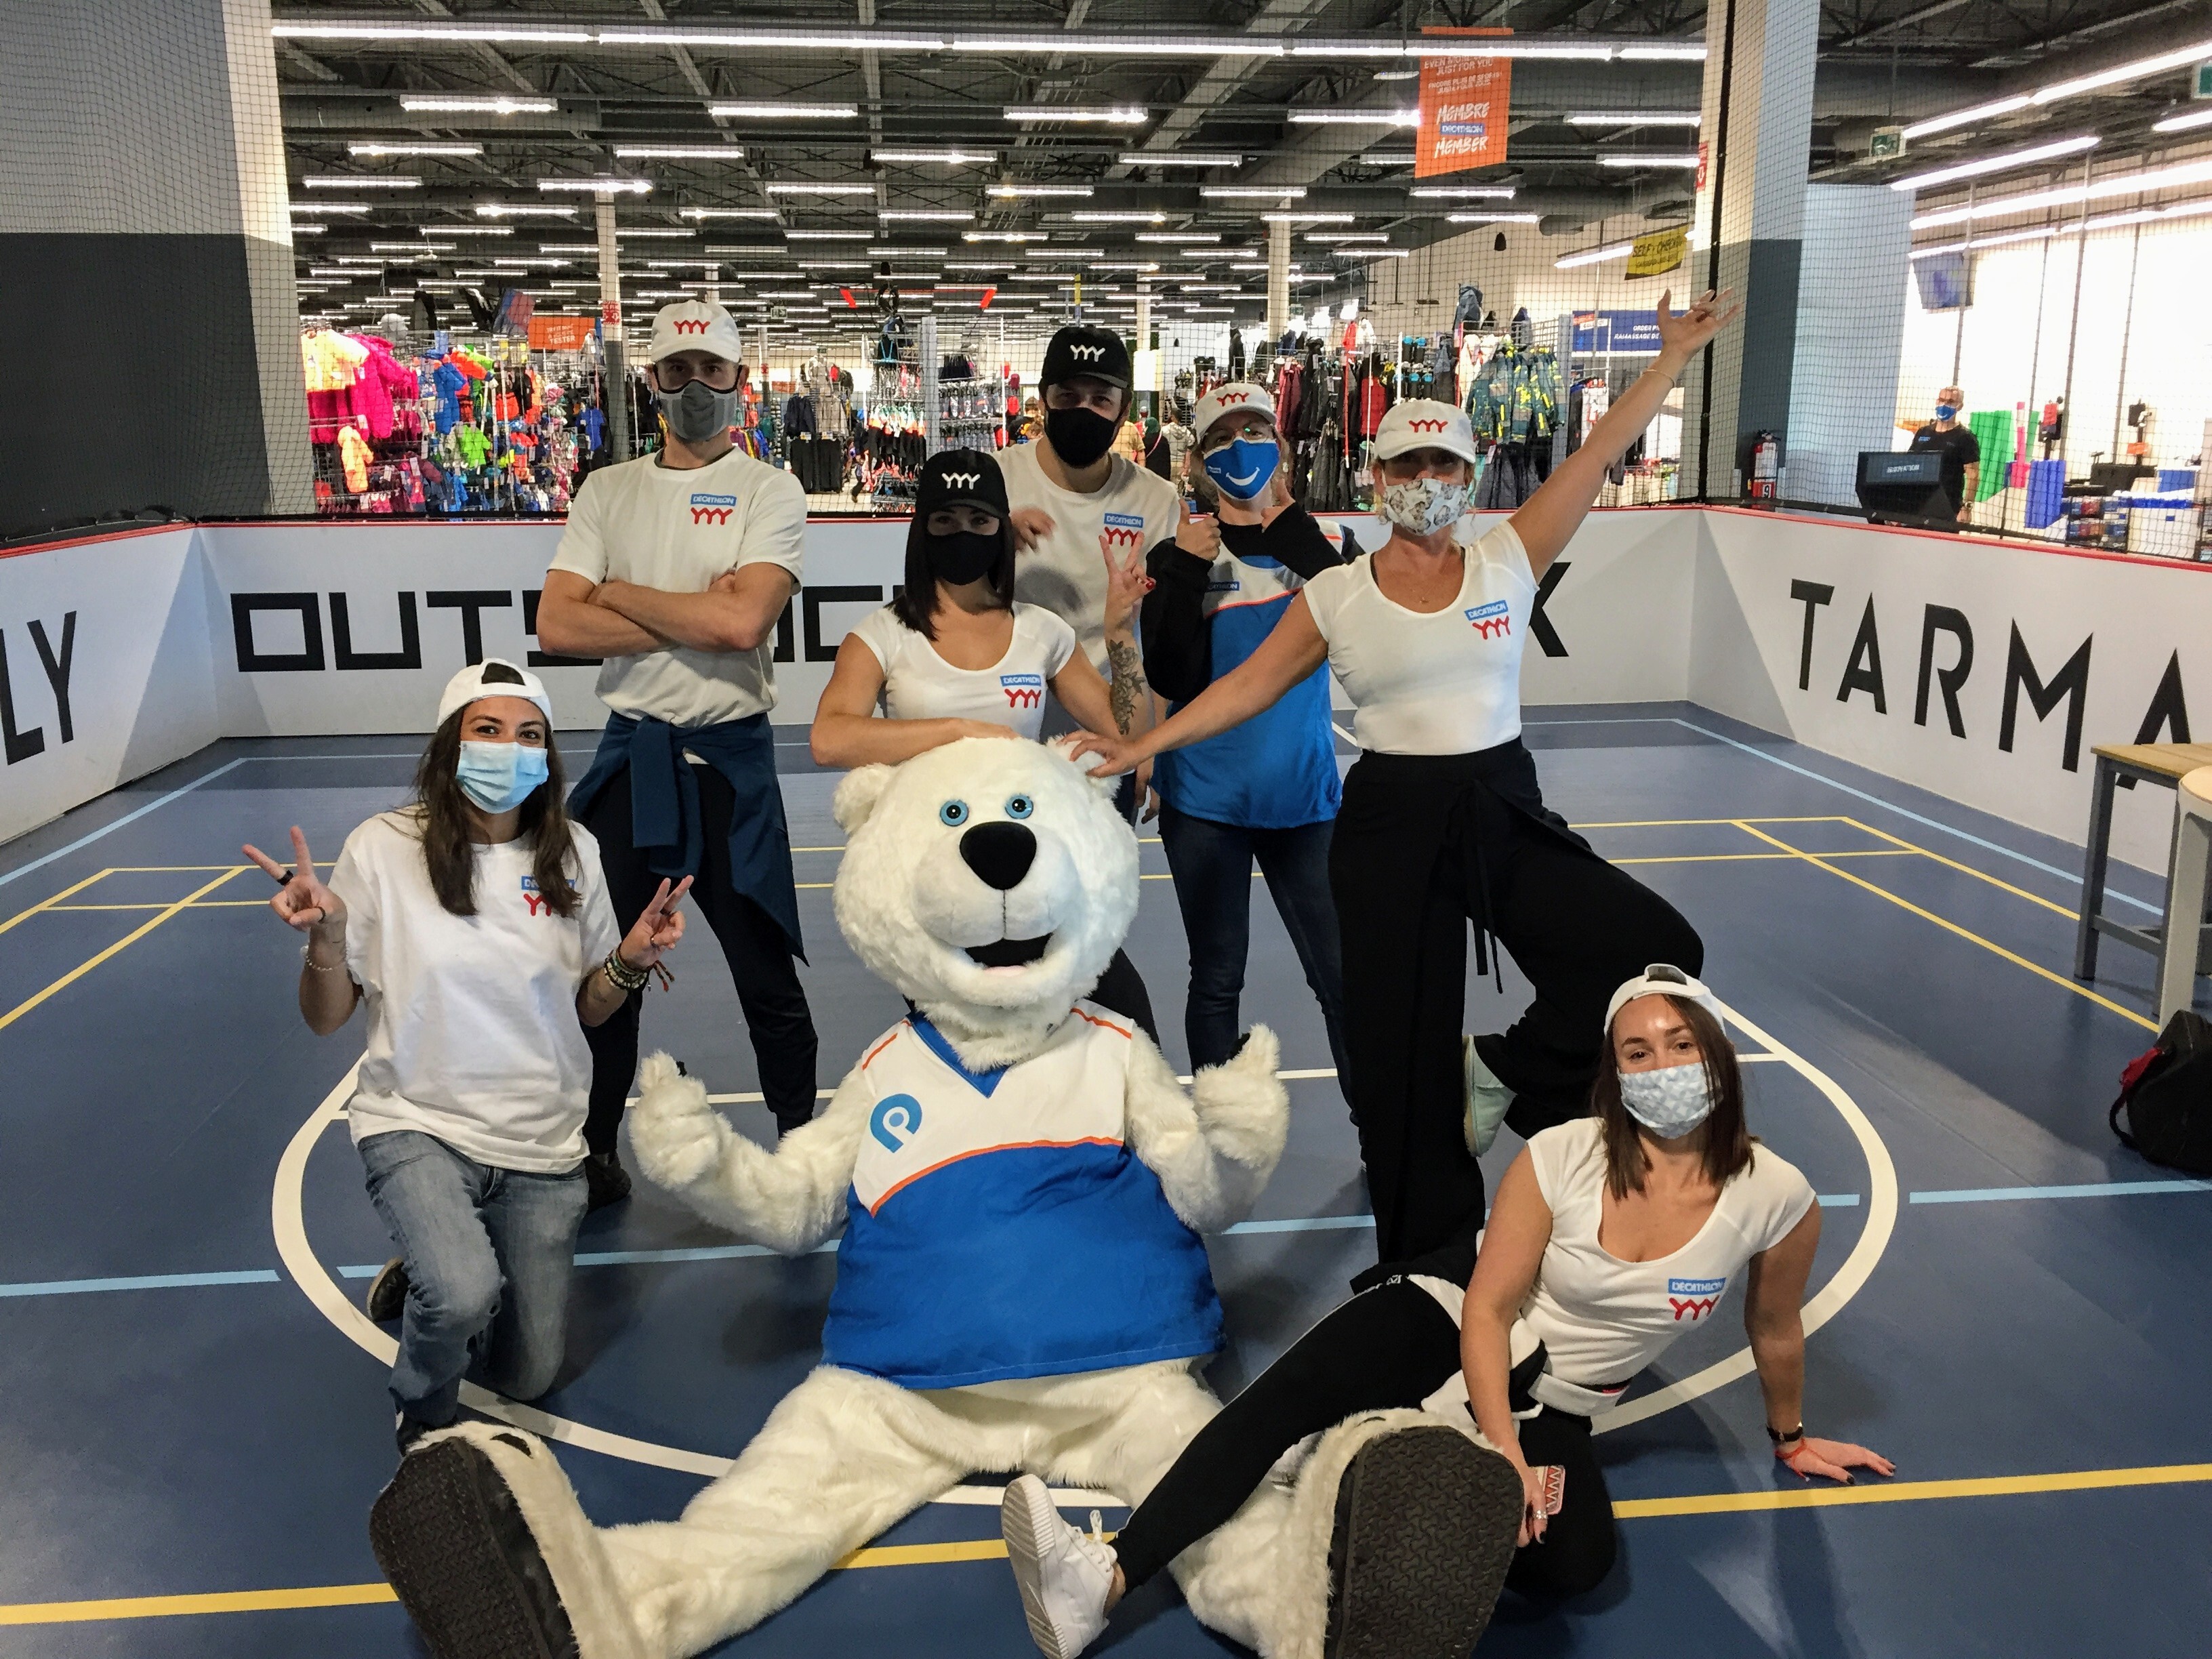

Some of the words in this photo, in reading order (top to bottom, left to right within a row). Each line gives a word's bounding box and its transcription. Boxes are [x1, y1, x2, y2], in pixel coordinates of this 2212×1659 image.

[1436, 102, 1490, 125] MEMBRE
[1434, 136, 1489, 159] MEMBER
[550, 335, 575, 344] TESTER
[693, 495, 734, 504] DECATHLON
[1106, 515, 1141, 526] DECATHLON
[1468, 602, 1507, 618] DECATHLON
[1672, 1282, 1723, 1292] DECATHLON
